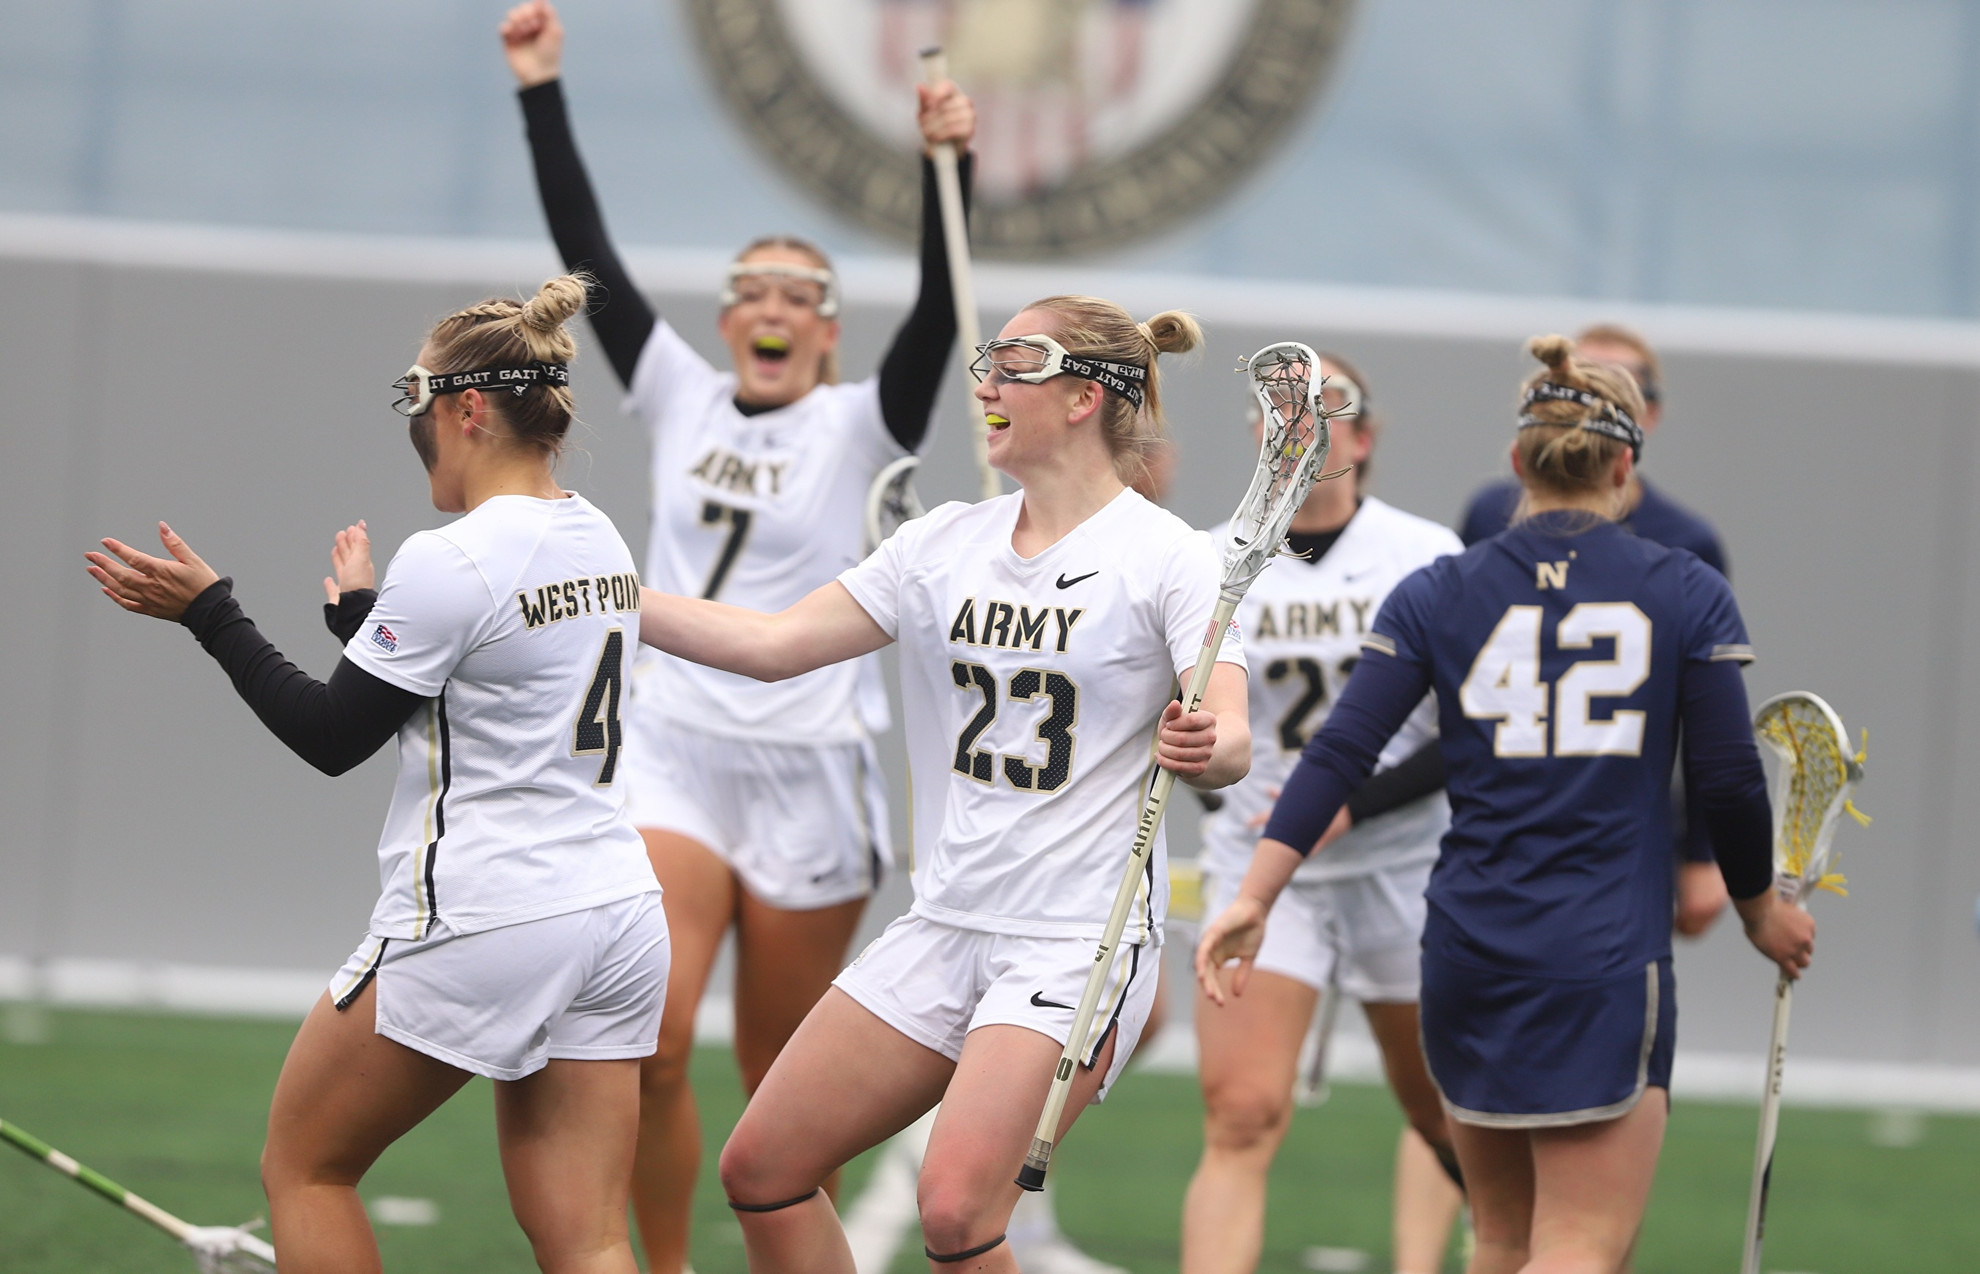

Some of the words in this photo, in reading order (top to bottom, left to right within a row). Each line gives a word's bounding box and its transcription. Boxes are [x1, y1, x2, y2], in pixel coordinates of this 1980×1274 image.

[430, 378, 446, 389] IT
[452, 371, 491, 386] GAIT
[499, 369, 539, 380] GAIT
[1061, 358, 1092, 376] GAI
[1096, 371, 1126, 391] GAIT
[690, 450, 787, 497] ARMY
[699, 500, 752, 600] 7
[1535, 561, 1570, 590] N
[516, 578, 593, 630] WEST
[594, 572, 640, 614] POIN
[949, 596, 1087, 655] ARMY
[1256, 598, 1373, 642] ARMY
[571, 626, 623, 788] 4
[1264, 655, 1360, 753] 2
[1459, 602, 1652, 758] 42
[951, 658, 1080, 794] 23
